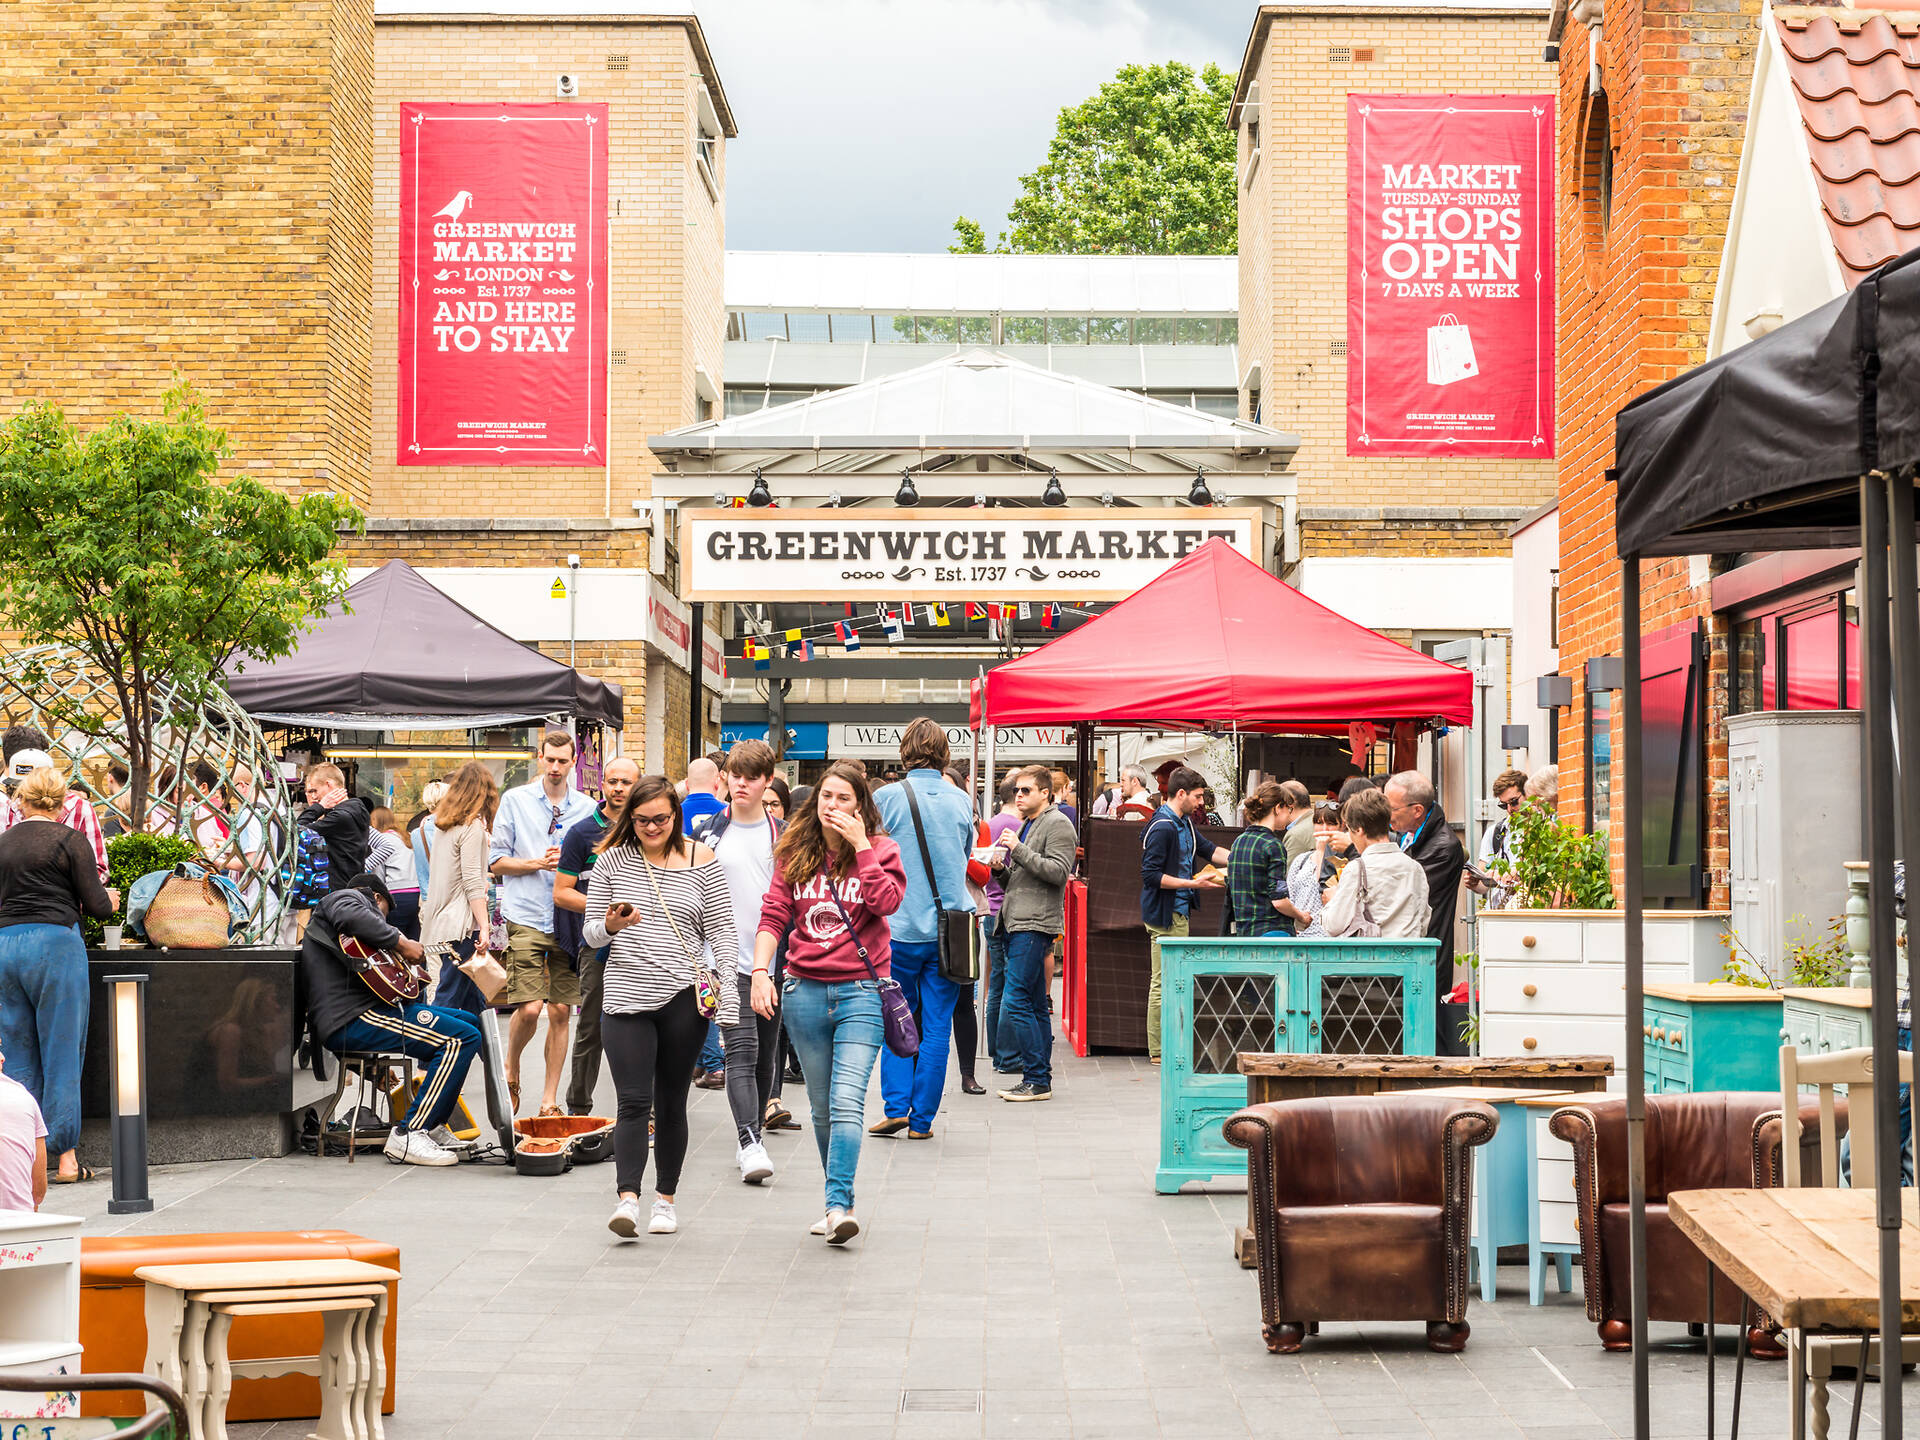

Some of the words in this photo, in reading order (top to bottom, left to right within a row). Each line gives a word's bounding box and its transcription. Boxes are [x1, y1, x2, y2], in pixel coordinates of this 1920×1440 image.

[1381, 163, 1522, 190] MARKET
[1381, 191, 1522, 206] TUESDAY-SUNDAY
[433, 222, 577, 239] GREENWICH
[1381, 206, 1522, 241] SHOPS
[433, 241, 577, 263] MARKET
[1381, 242, 1521, 281] OPEN
[464, 267, 544, 282] LONDON
[477, 285, 501, 297] Est.
[502, 285, 532, 297] 1737
[1382, 282, 1392, 298] 7
[1397, 283, 1445, 298] DAYS
[1448, 283, 1463, 298] A
[1466, 283, 1520, 298] WEEK
[432, 301, 498, 323] AND
[504, 301, 576, 323] HERE
[433, 325, 481, 353] TO
[490, 325, 576, 353] STAY
[707, 530, 1006, 561] GREENWICH
[935, 567, 966, 582] Est.
[971, 566, 1007, 581] 1737
